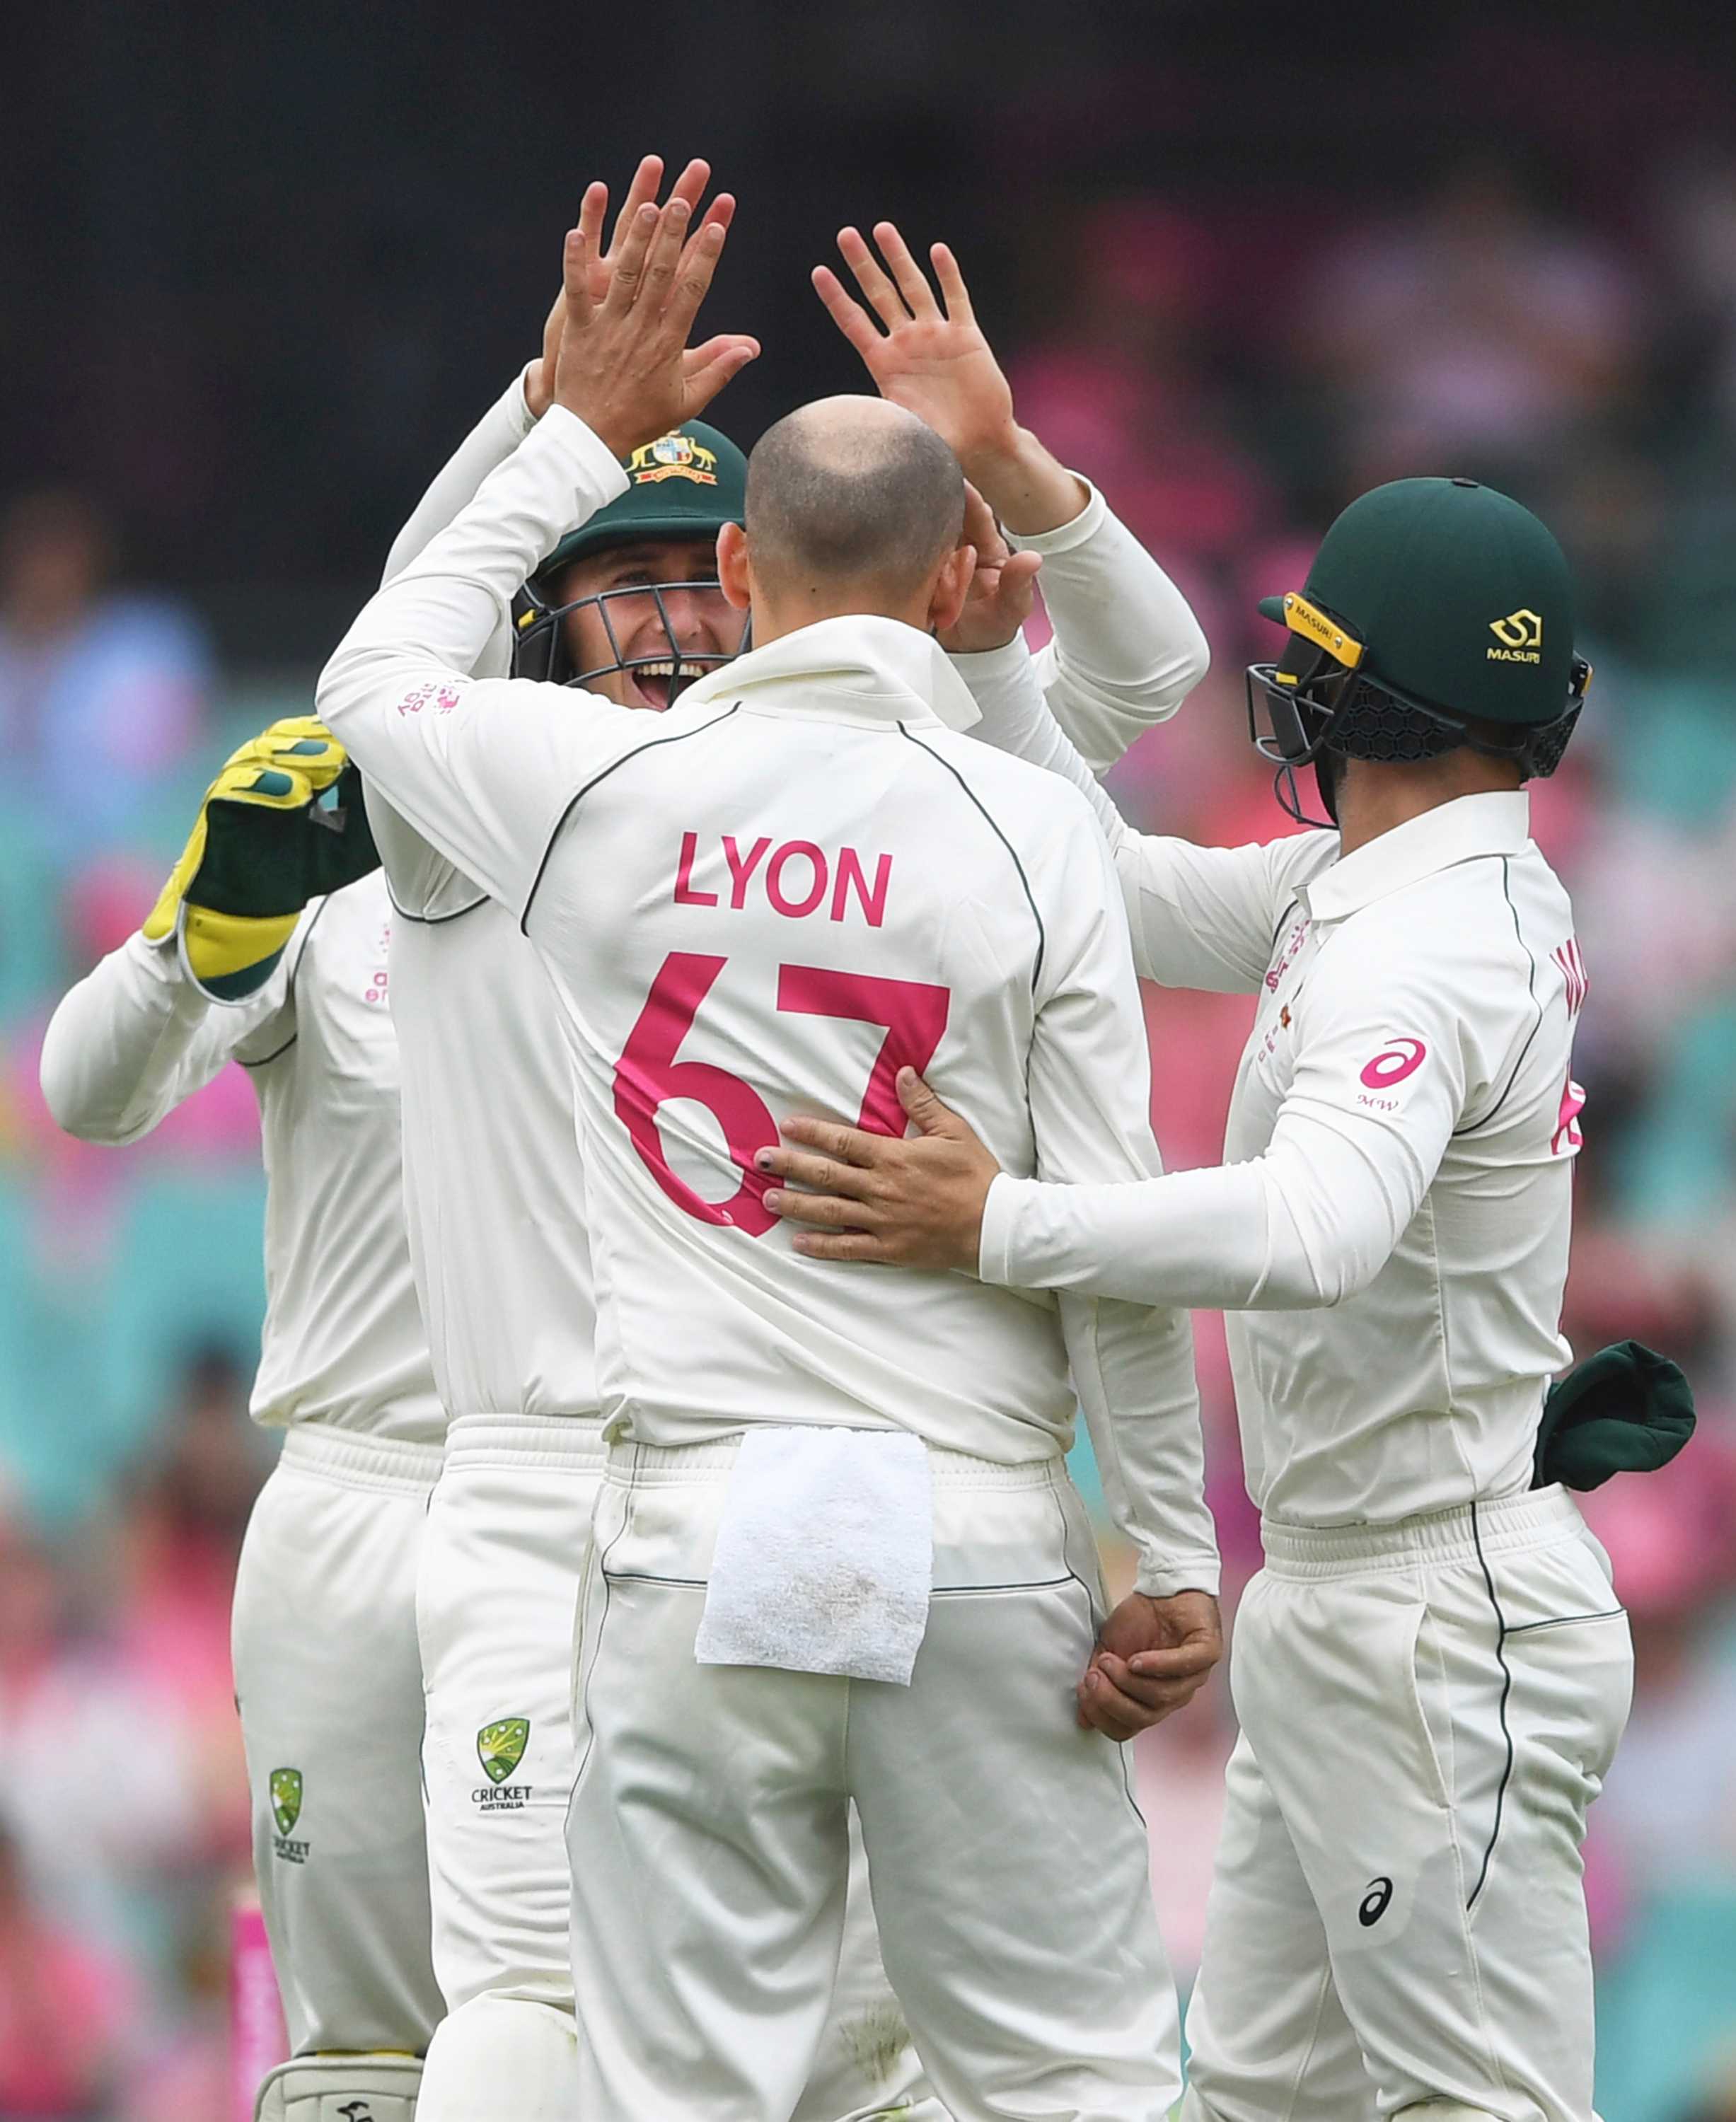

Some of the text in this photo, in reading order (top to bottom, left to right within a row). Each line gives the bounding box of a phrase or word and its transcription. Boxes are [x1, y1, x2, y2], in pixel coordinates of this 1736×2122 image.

[1295, 605, 1333, 640] MASURI
[1486, 647, 1541, 664] MASURI
[673, 831, 893, 928] LYON
[612, 951, 951, 1238] 67
[471, 1785, 533, 1803] CRICKET
[480, 1801, 525, 1811] AUSTRALIA
